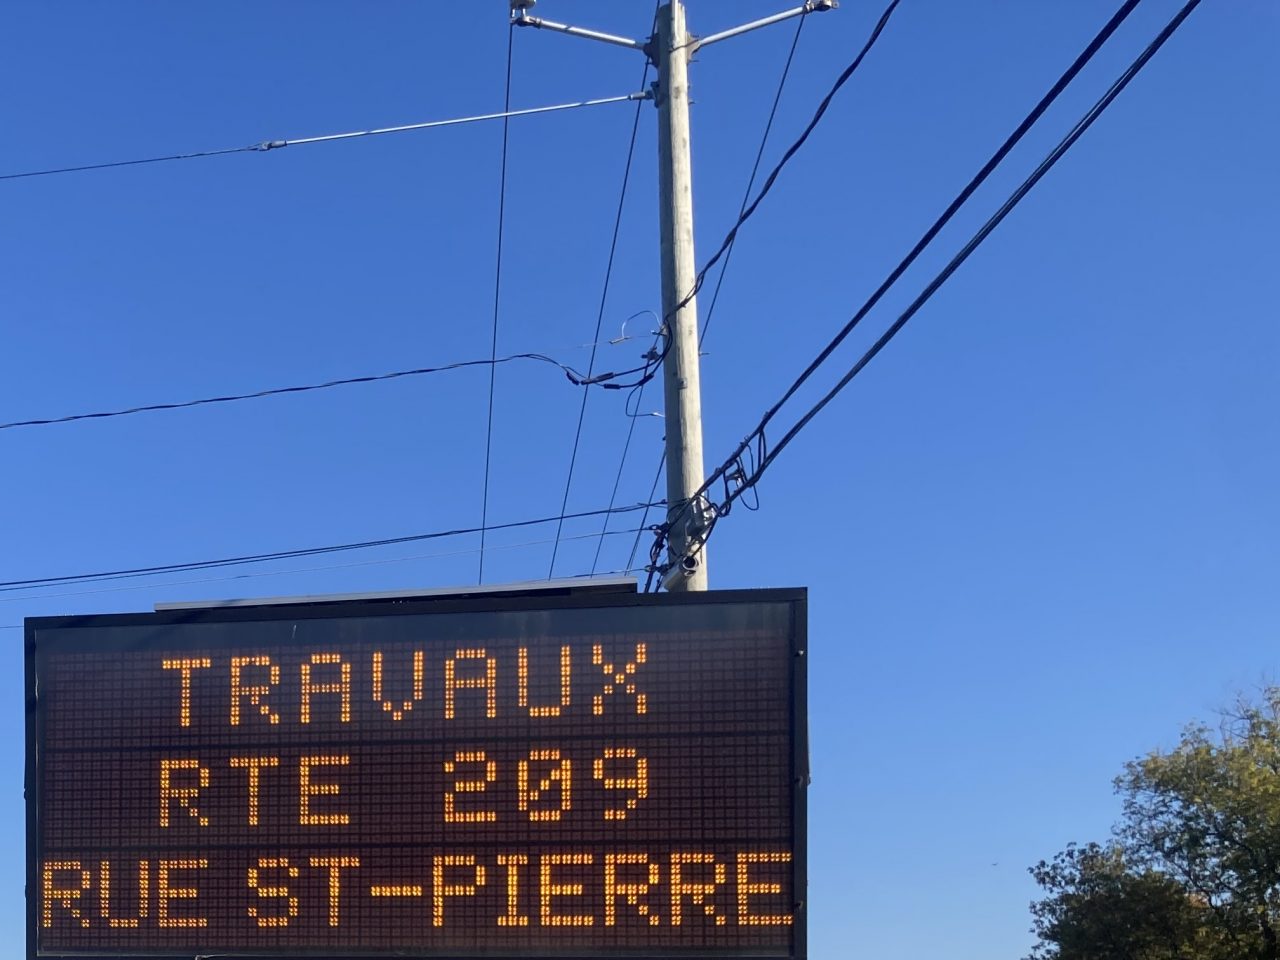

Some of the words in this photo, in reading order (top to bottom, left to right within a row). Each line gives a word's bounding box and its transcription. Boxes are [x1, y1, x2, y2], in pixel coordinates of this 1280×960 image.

[162, 643, 647, 726] TRAVAUX
[159, 755, 350, 828] RTE
[444, 748, 649, 822] 209
[41, 858, 208, 928] RUE
[247, 852, 793, 927] ST-PIERRE
